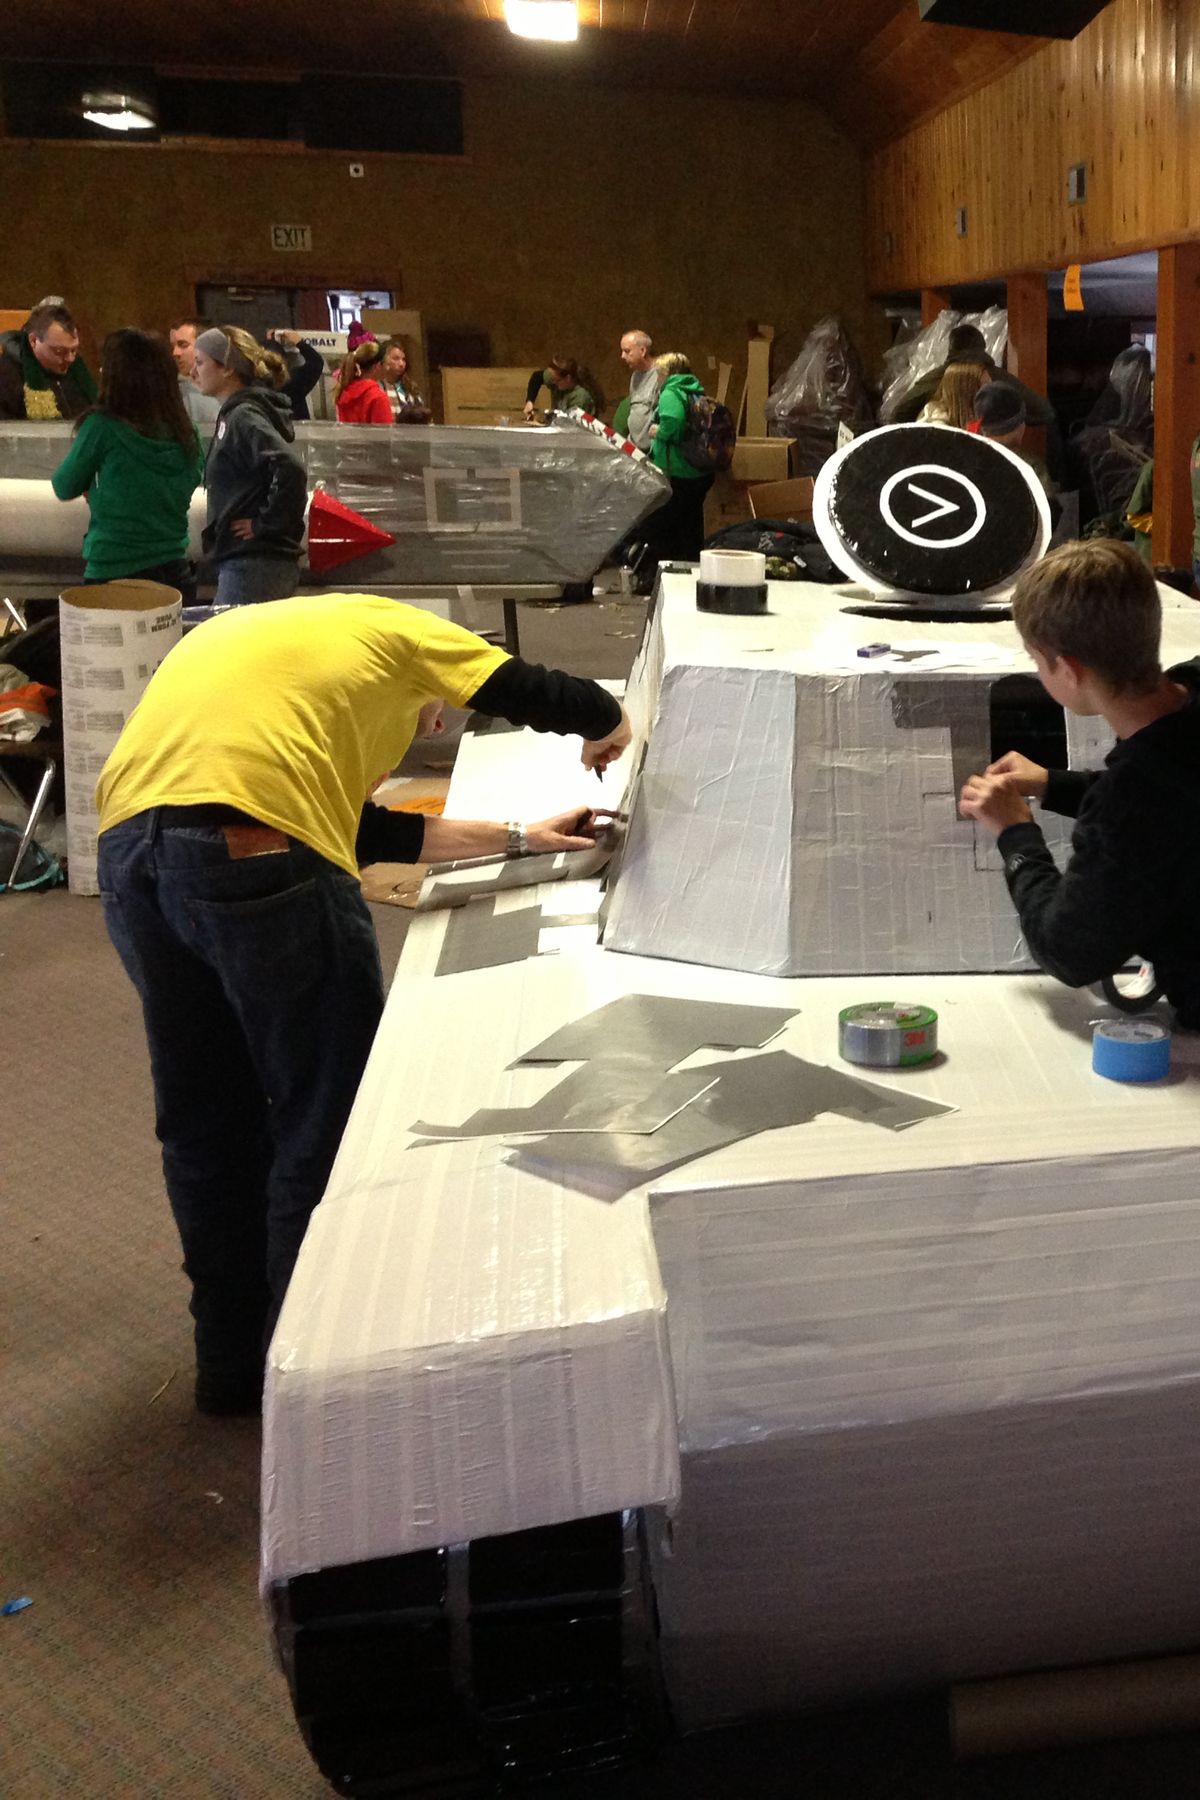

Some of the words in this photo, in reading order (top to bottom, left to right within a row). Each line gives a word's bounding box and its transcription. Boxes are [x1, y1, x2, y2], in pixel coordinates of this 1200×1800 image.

[273, 227, 306, 248] EXIT
[301, 337, 336, 346] OBALT
[903, 1030, 926, 1048] 3M
